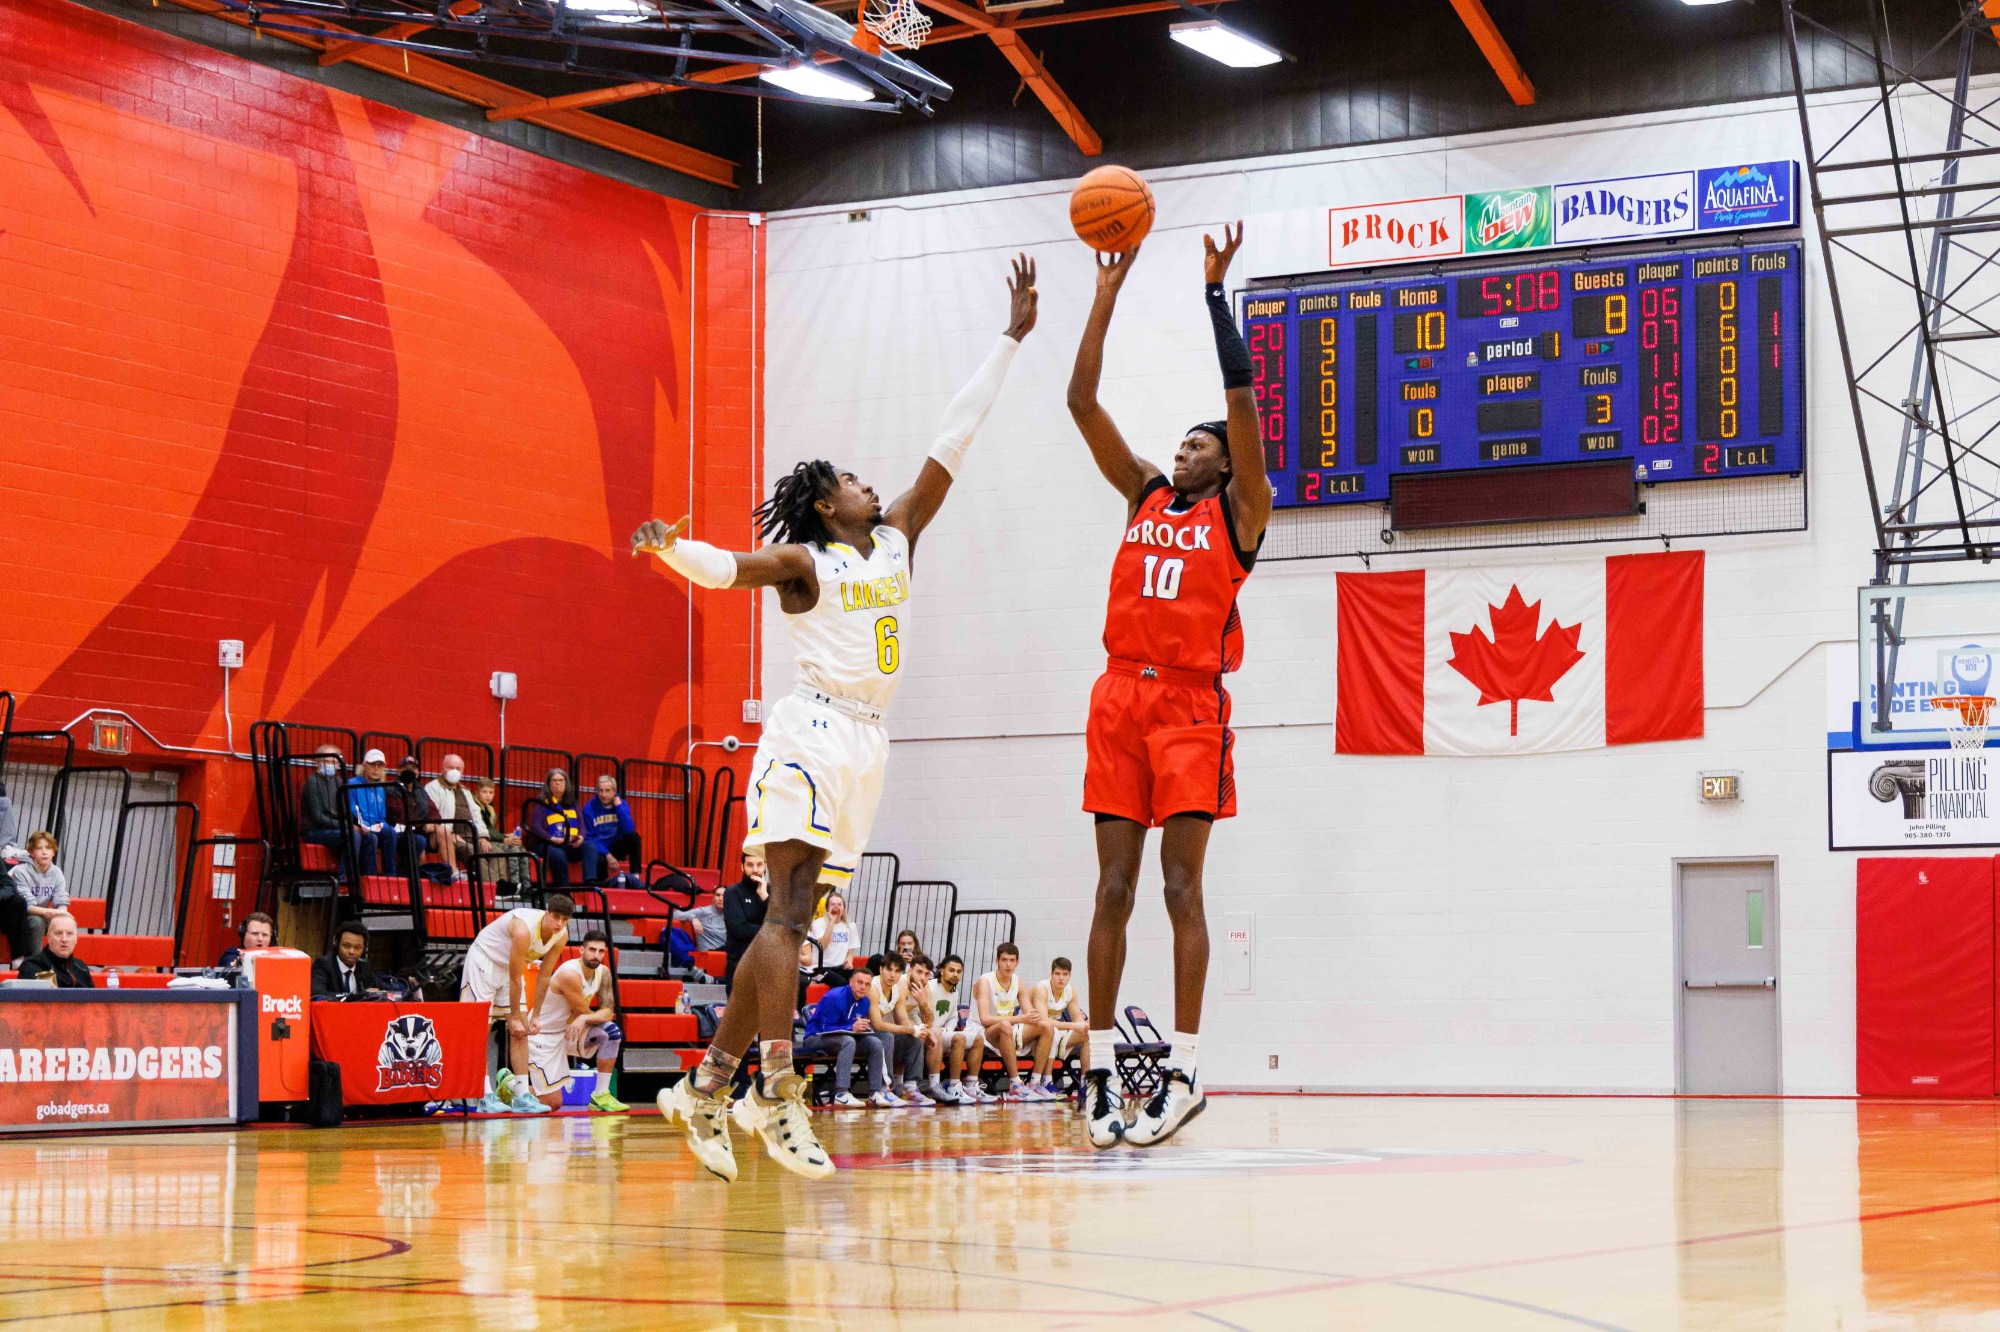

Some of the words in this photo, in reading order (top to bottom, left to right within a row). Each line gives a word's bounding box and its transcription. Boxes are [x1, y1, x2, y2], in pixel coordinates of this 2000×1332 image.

[1704, 174, 1778, 211] AQUAFINA
[1561, 188, 1688, 226] BADGERS
[1342, 214, 1450, 248] BROCK
[1638, 264, 1679, 284] player
[1697, 257, 1739, 278] points
[1751, 253, 1786, 271] fouls
[1482, 271, 1559, 315] 5:08
[1574, 271, 1624, 291] Guests
[1247, 300, 1285, 319] player
[1300, 295, 1338, 315] points
[1350, 288, 1381, 308] fouls
[1400, 289, 1438, 306] Home
[1642, 287, 1678, 317] 06
[1719, 281, 1735, 311] 0
[1605, 294, 1627, 334] 8
[1719, 313, 1736, 343] 6
[1250, 323, 1283, 352] 20
[1320, 318, 1335, 346] 0
[1416, 311, 1446, 350] 10
[1642, 318, 1678, 349] 07
[1320, 348, 1336, 376] 2
[1486, 338, 1532, 361] period
[1720, 345, 1736, 374] 0
[1252, 354, 1283, 382] 01
[1583, 369, 1617, 386] fouls
[1653, 352, 1678, 378] 11
[1320, 378, 1336, 407] 0
[1404, 382, 1436, 400] fouls
[1486, 374, 1532, 395] player
[1653, 382, 1678, 410] 15
[1720, 377, 1737, 406] 0
[1321, 409, 1336, 437] 0
[1417, 408, 1433, 437] 0
[1597, 394, 1611, 424] 3
[1643, 413, 1679, 444] 02
[1720, 409, 1737, 438] 0
[1321, 439, 1336, 467] 2
[1408, 449, 1434, 463] won
[1492, 442, 1527, 460] game
[1587, 436, 1614, 450] won
[1703, 444, 1719, 473] 2
[1305, 472, 1320, 500] 2
[1126, 519, 1211, 551] BROCK
[1141, 554, 1185, 600] 10
[875, 615, 899, 674] 6
[1871, 680, 1956, 699] RNTING
[1704, 778, 1732, 797] EXIT
[1930, 757, 1987, 791] PILLING
[1930, 792, 1989, 819] FINANCIAL
[262, 994, 302, 1012] Brock
[0, 1046, 222, 1082] AREBADGERS
[378, 1064, 442, 1090] BADGERS
[36, 1101, 109, 1119] gobadgers.ca
